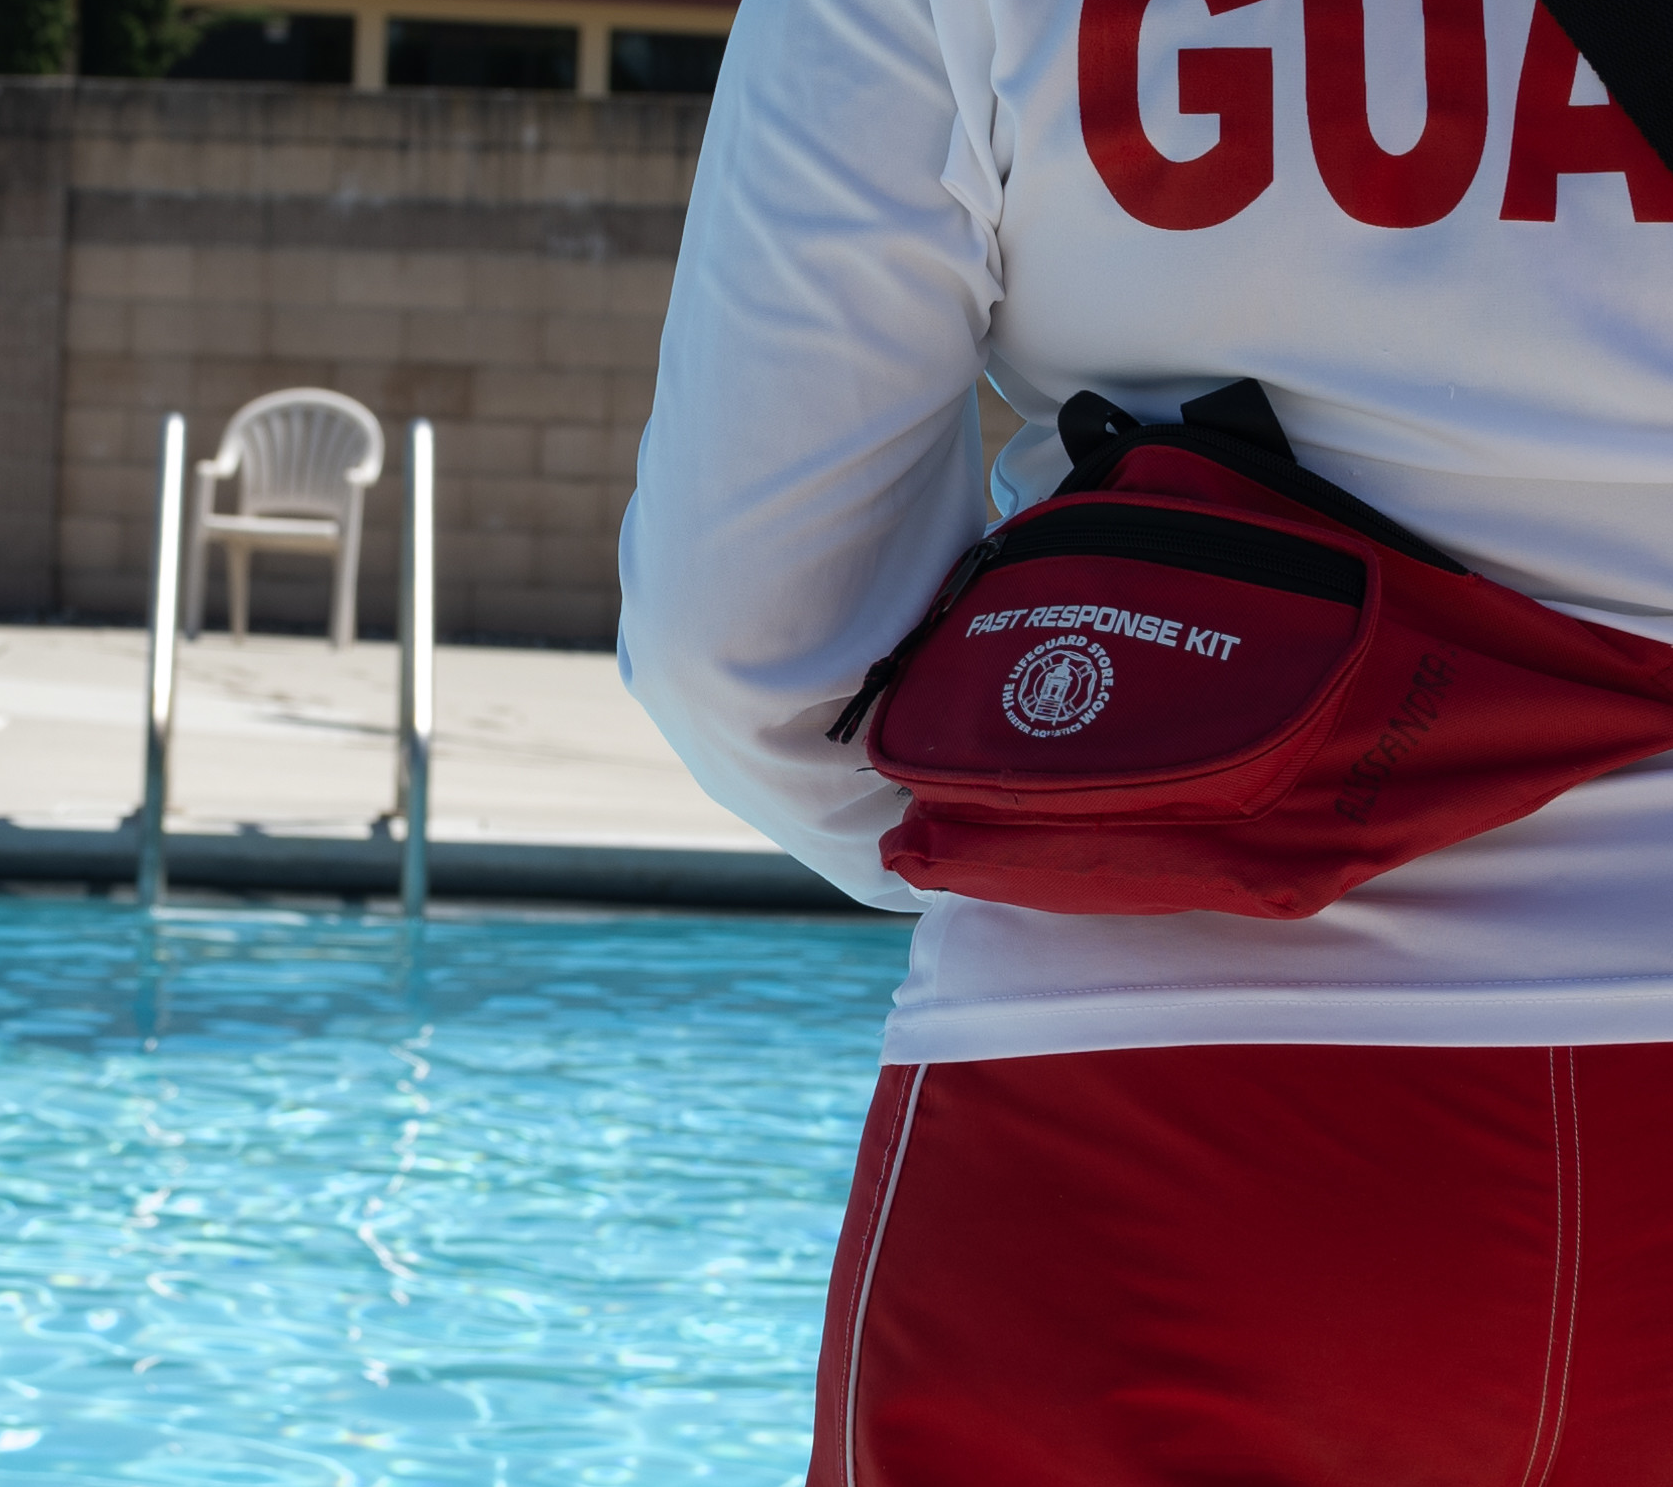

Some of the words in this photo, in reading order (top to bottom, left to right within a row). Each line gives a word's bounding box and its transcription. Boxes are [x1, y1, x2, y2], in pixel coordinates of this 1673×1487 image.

[965, 609, 1028, 638] FAST
[1024, 605, 1183, 647] RESPONSE
[1184, 626, 1241, 661] KIT
[1008, 635, 1088, 679] LIFEGUARD
[1002, 683, 1015, 710] THE
